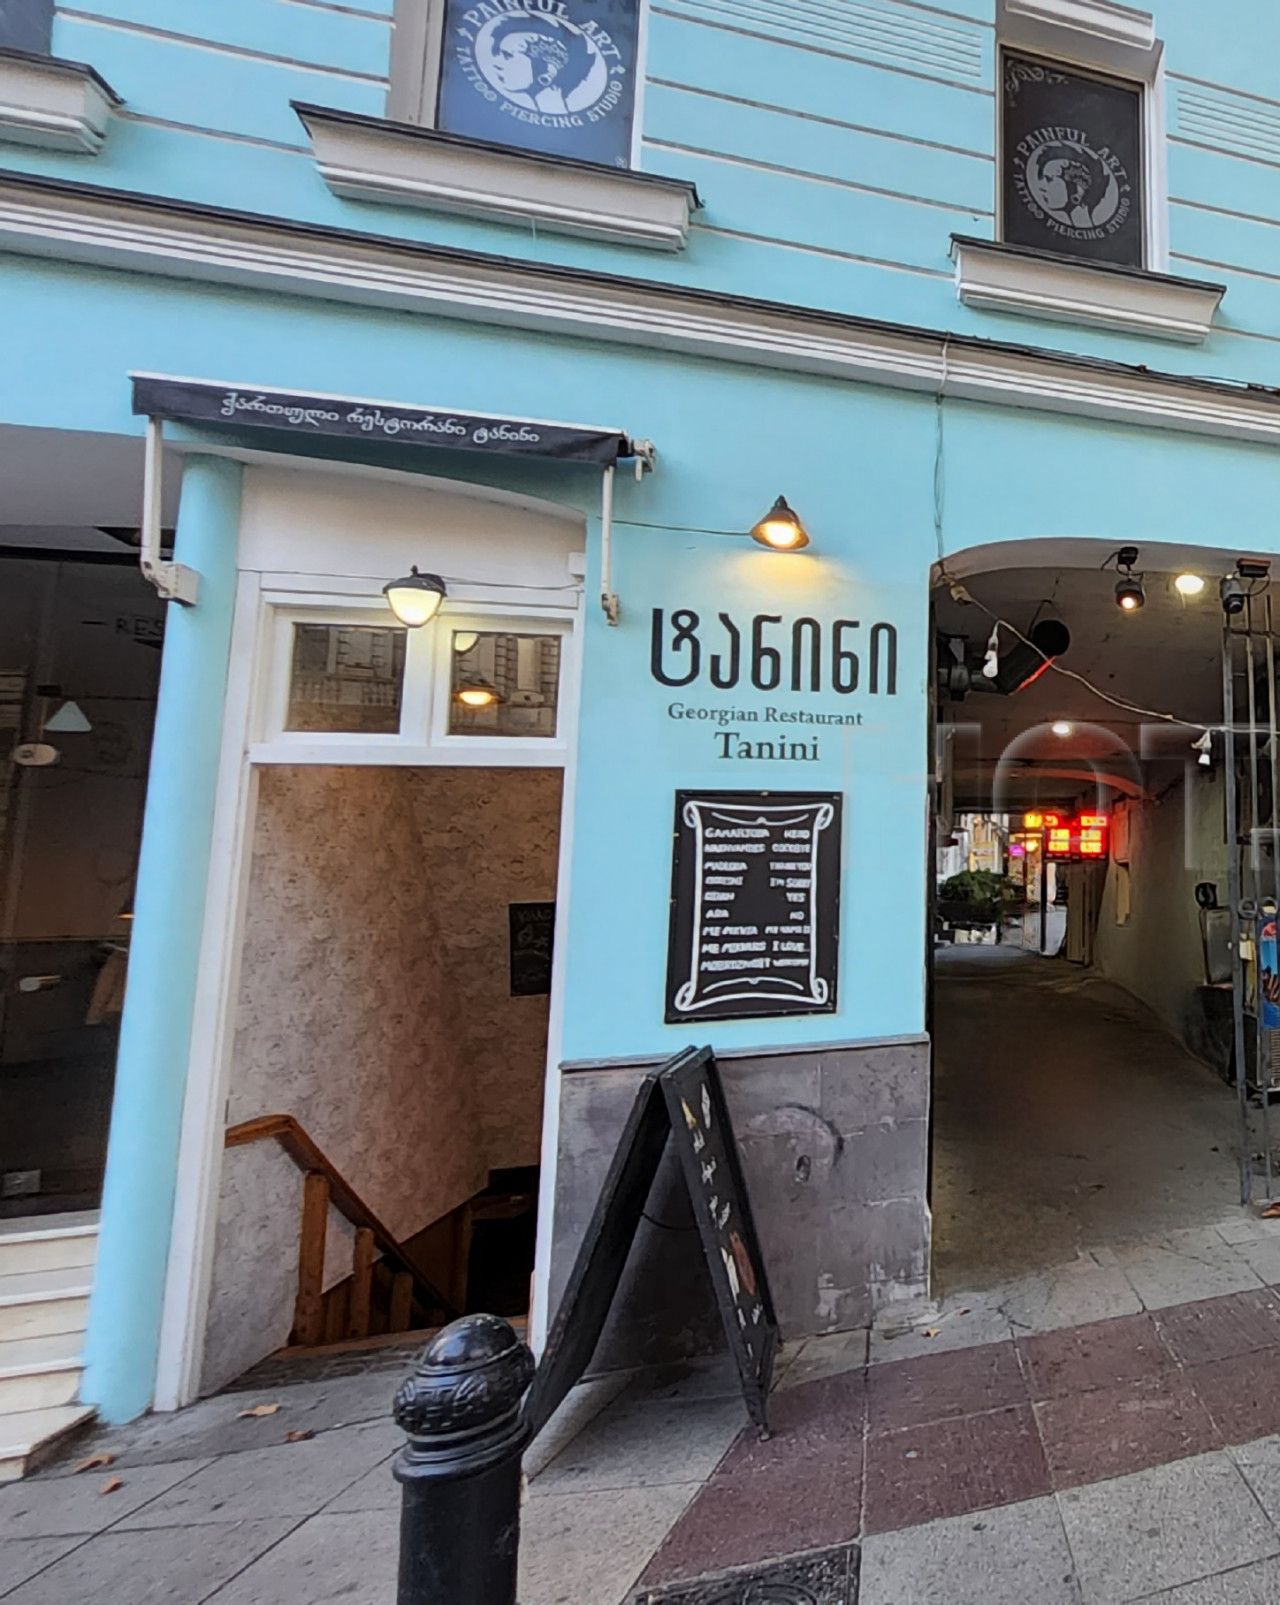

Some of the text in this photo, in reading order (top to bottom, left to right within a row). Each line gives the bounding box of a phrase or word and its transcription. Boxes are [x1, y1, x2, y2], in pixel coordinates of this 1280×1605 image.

[579, 20, 622, 61] ART
[456, 47, 623, 128] TATTOO PIERCING STUDIO
[1016, 127, 1128, 180] PAINFUL ART
[1013, 173, 1131, 240] TATTOO PIERCING STUDIO
[221, 391, 541, 444] ქართული რესტორანი ტანინი
[650, 607, 898, 695] ტანინი
[667, 702, 863, 727] Georgian Restaurant
[714, 731, 820, 761] Tanini
